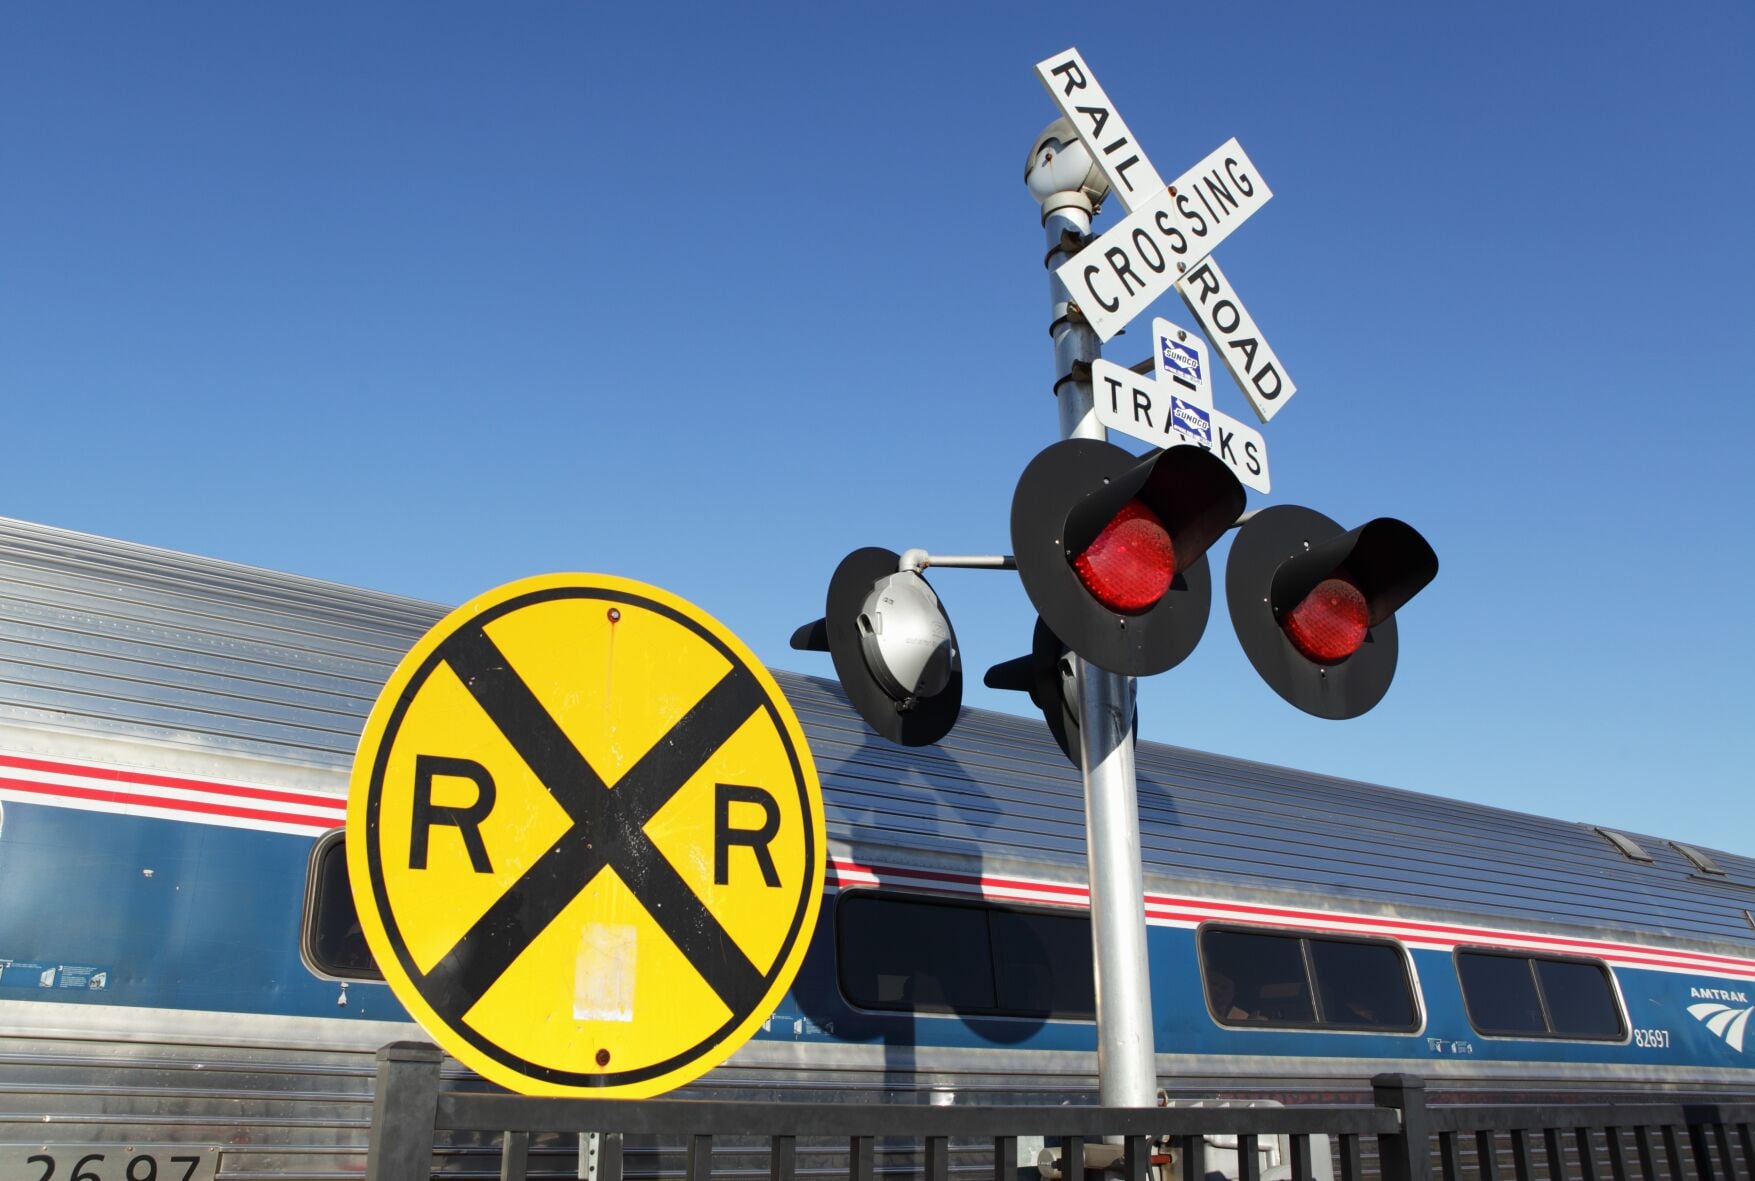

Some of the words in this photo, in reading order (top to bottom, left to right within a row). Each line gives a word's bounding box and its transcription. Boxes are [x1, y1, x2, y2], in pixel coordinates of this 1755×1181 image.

[1051, 59, 1140, 192] RAIL
[1187, 263, 1282, 401] ROAD
[1083, 157, 1254, 313] CROSSING
[1166, 349, 1198, 369] SUNOCO
[1103, 376, 1261, 476] TRKS
[1175, 408, 1208, 429] SUNOCO
[409, 754, 496, 874] R
[714, 783, 782, 888] R
[1690, 987, 1748, 1003] AMTRAK
[1633, 1028, 1670, 1048] 82697
